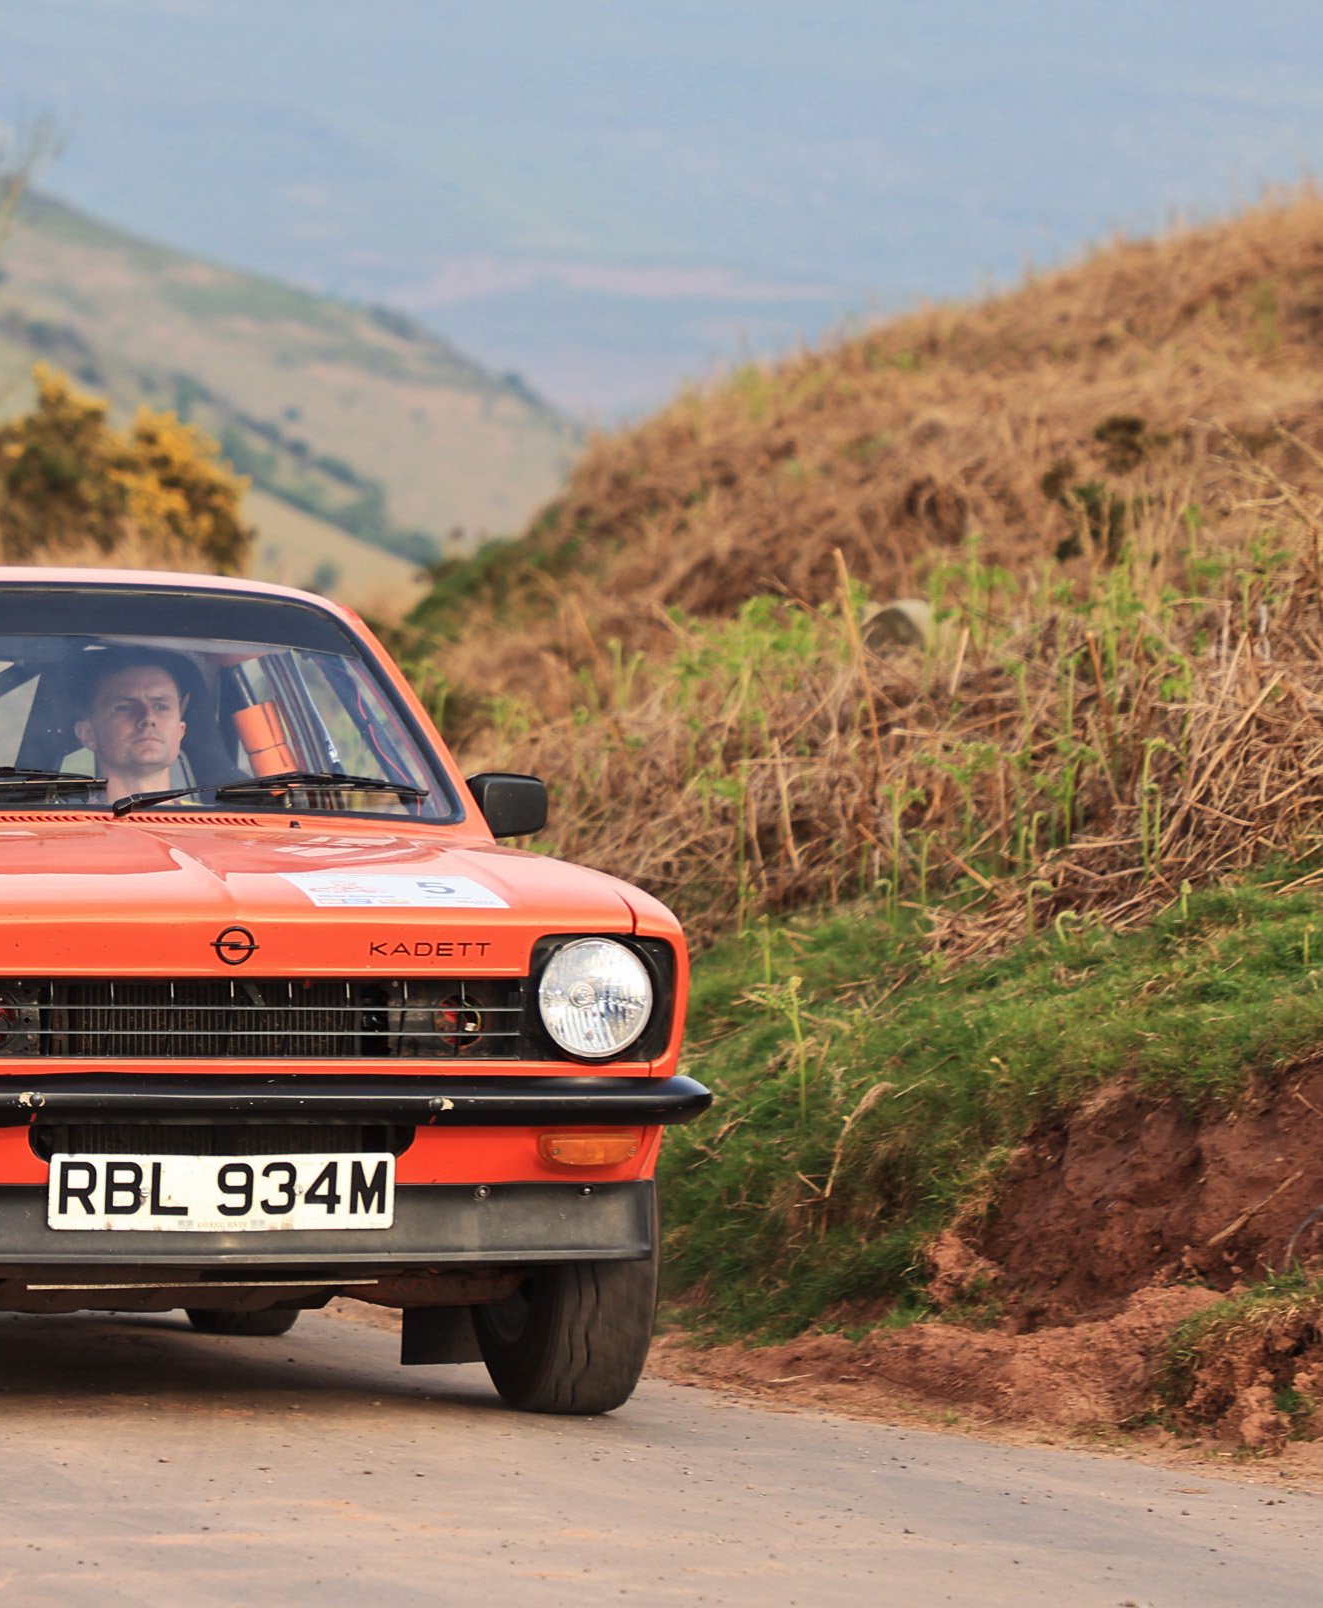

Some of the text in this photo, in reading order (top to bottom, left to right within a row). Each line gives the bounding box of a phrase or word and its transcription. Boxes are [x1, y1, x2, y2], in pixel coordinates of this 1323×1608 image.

[416, 882, 456, 894] 5
[369, 942, 492, 956] KADETT
[58, 1160, 388, 1217] RBL 934M
